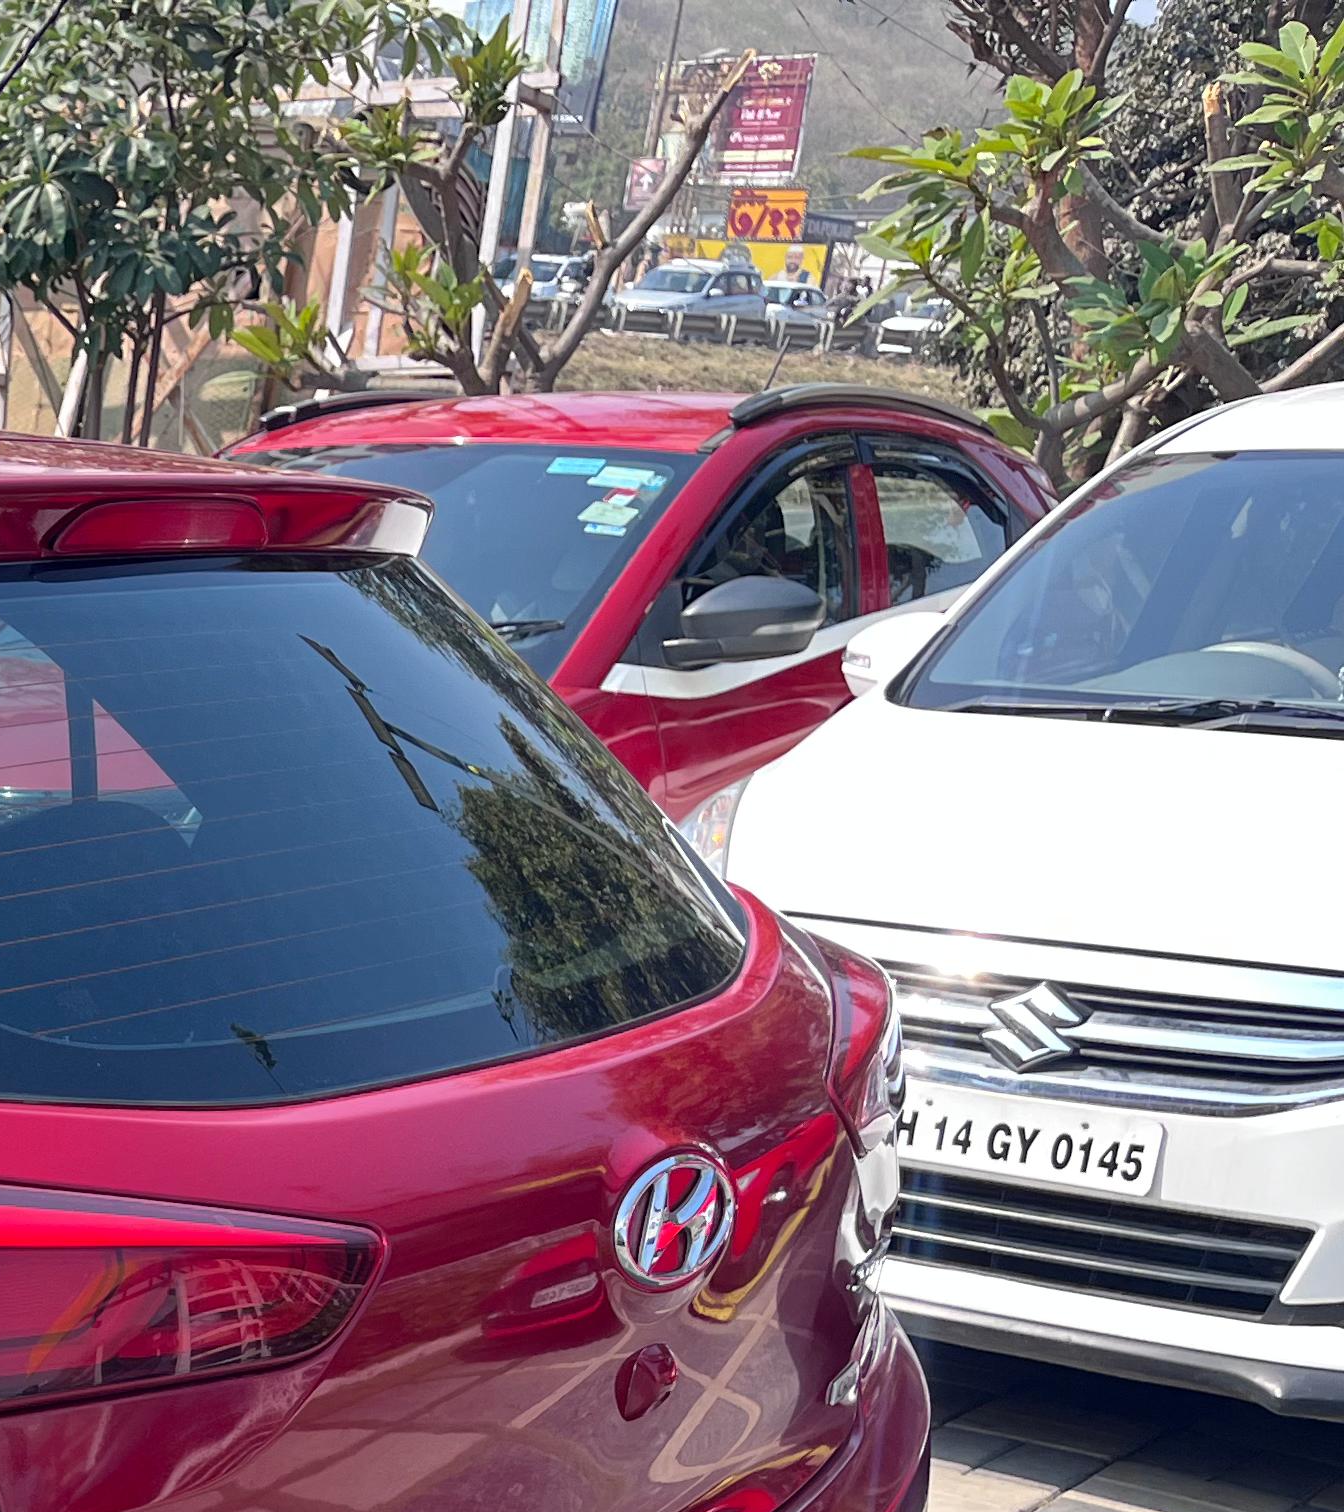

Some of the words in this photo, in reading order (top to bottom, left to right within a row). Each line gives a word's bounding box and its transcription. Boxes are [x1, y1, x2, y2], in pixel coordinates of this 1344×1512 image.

[932, 1116, 974, 1155] 14
[985, 1122, 1042, 1164] GY
[1050, 1132, 1146, 1182] 0145
